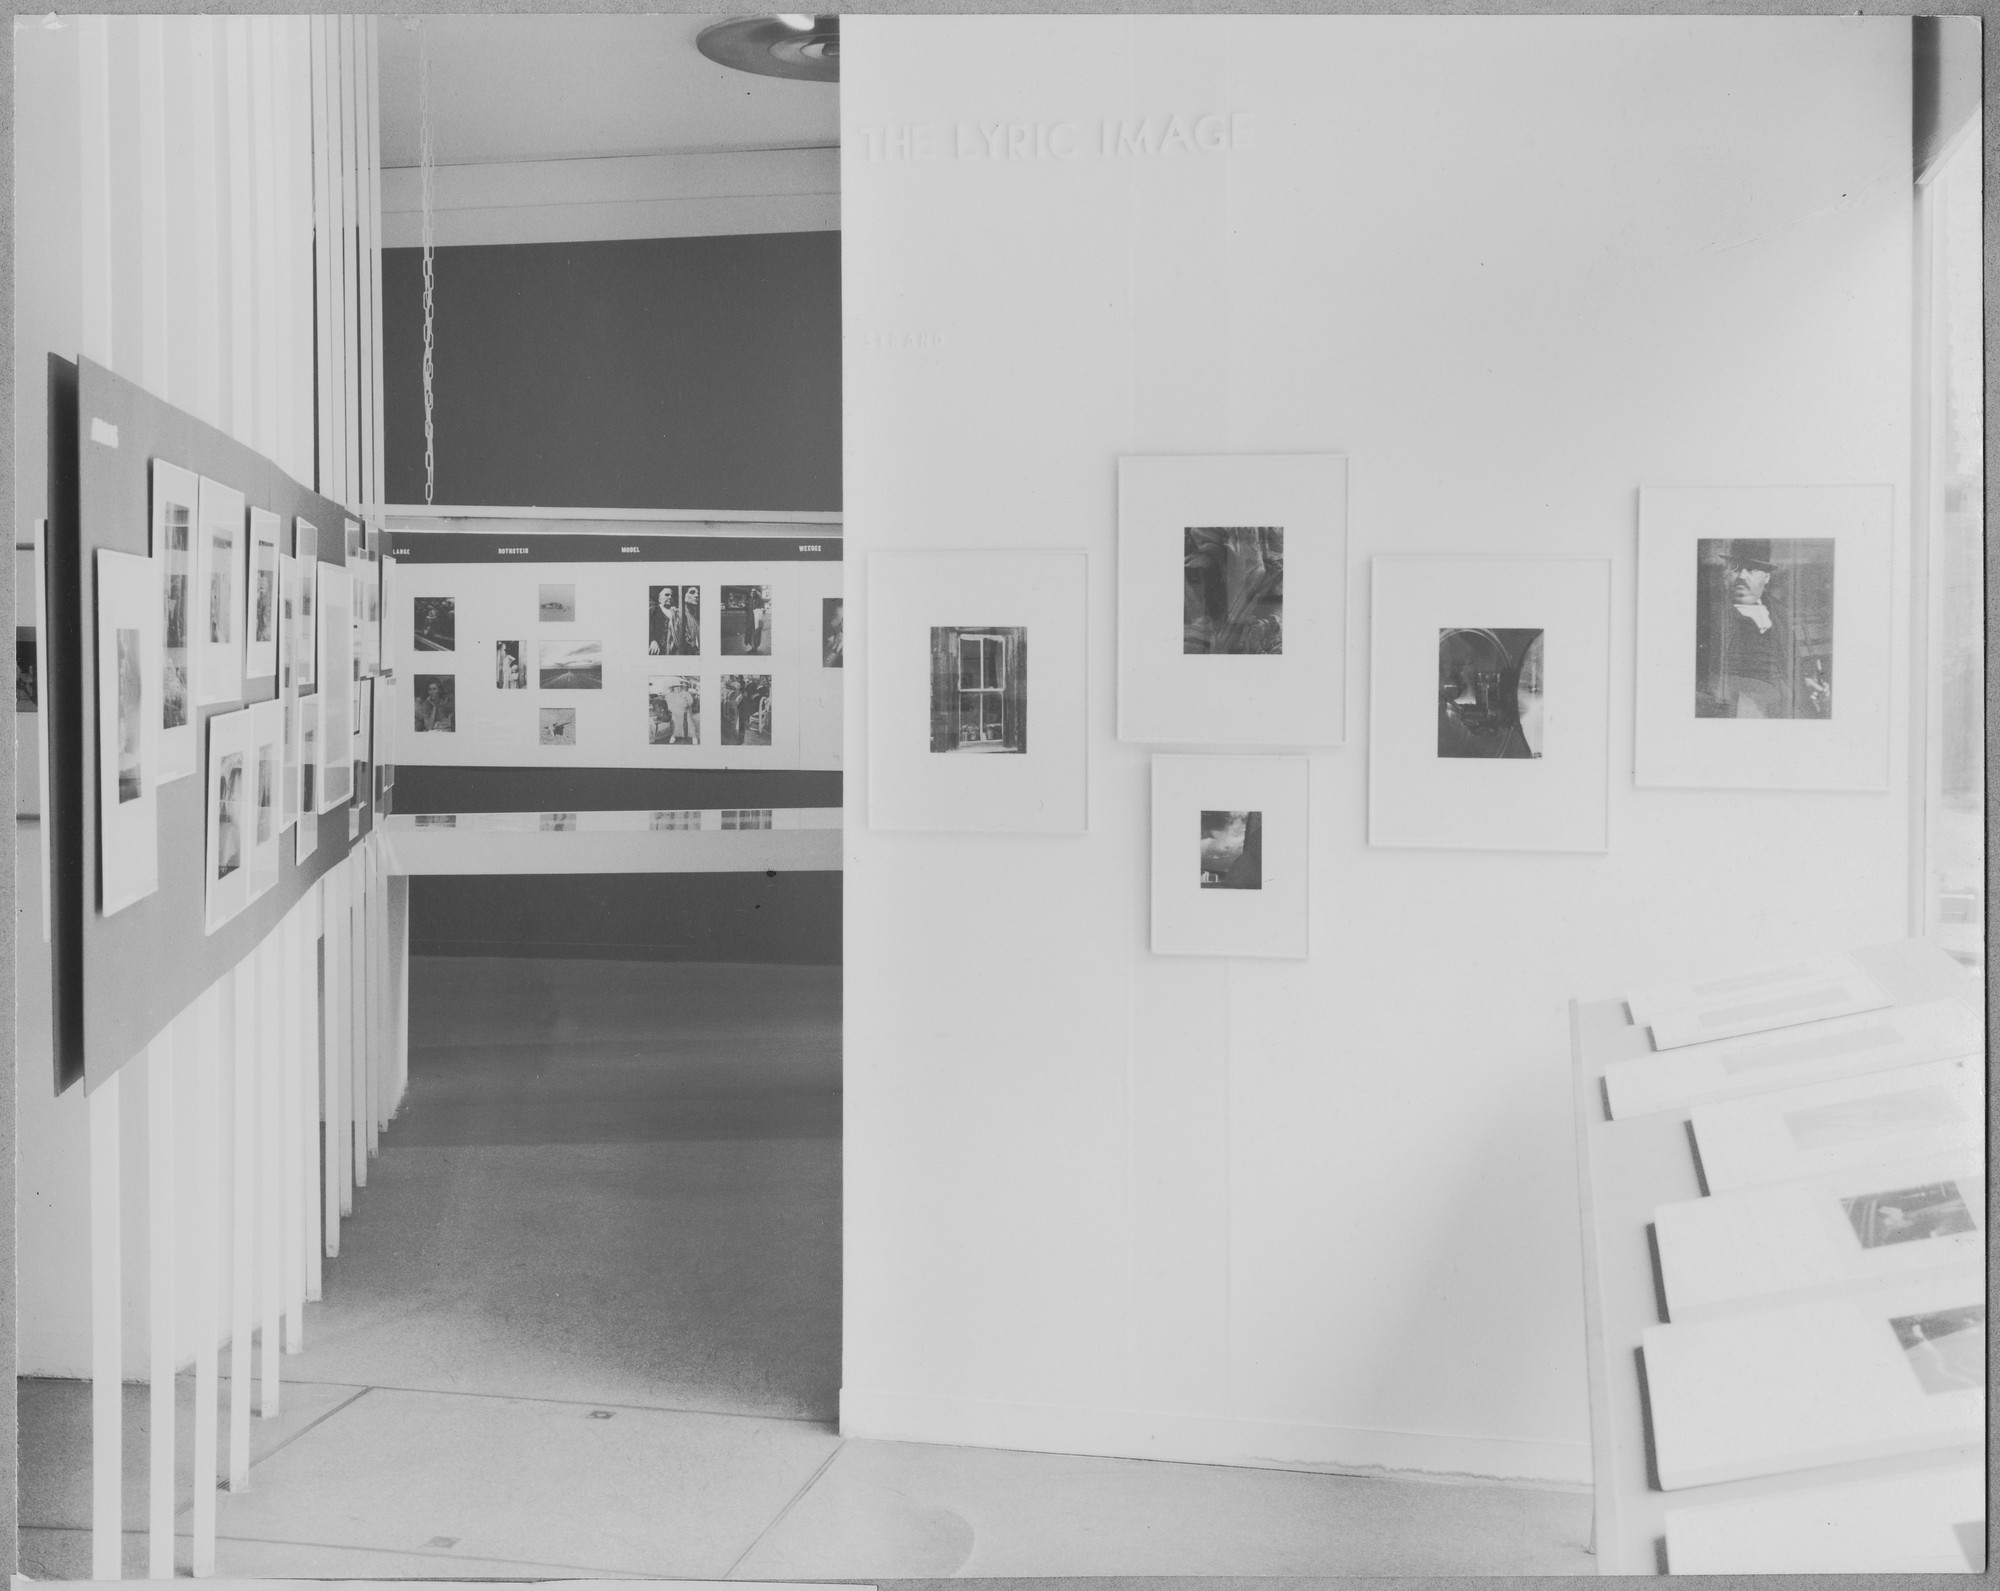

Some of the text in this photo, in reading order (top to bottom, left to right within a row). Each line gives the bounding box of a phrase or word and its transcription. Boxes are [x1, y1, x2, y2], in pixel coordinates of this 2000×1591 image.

[858, 112, 1256, 162] THE LYRIC IMAGE
[621, 546, 640, 554] MODEL
[799, 545, 822, 553] WEEGEE
